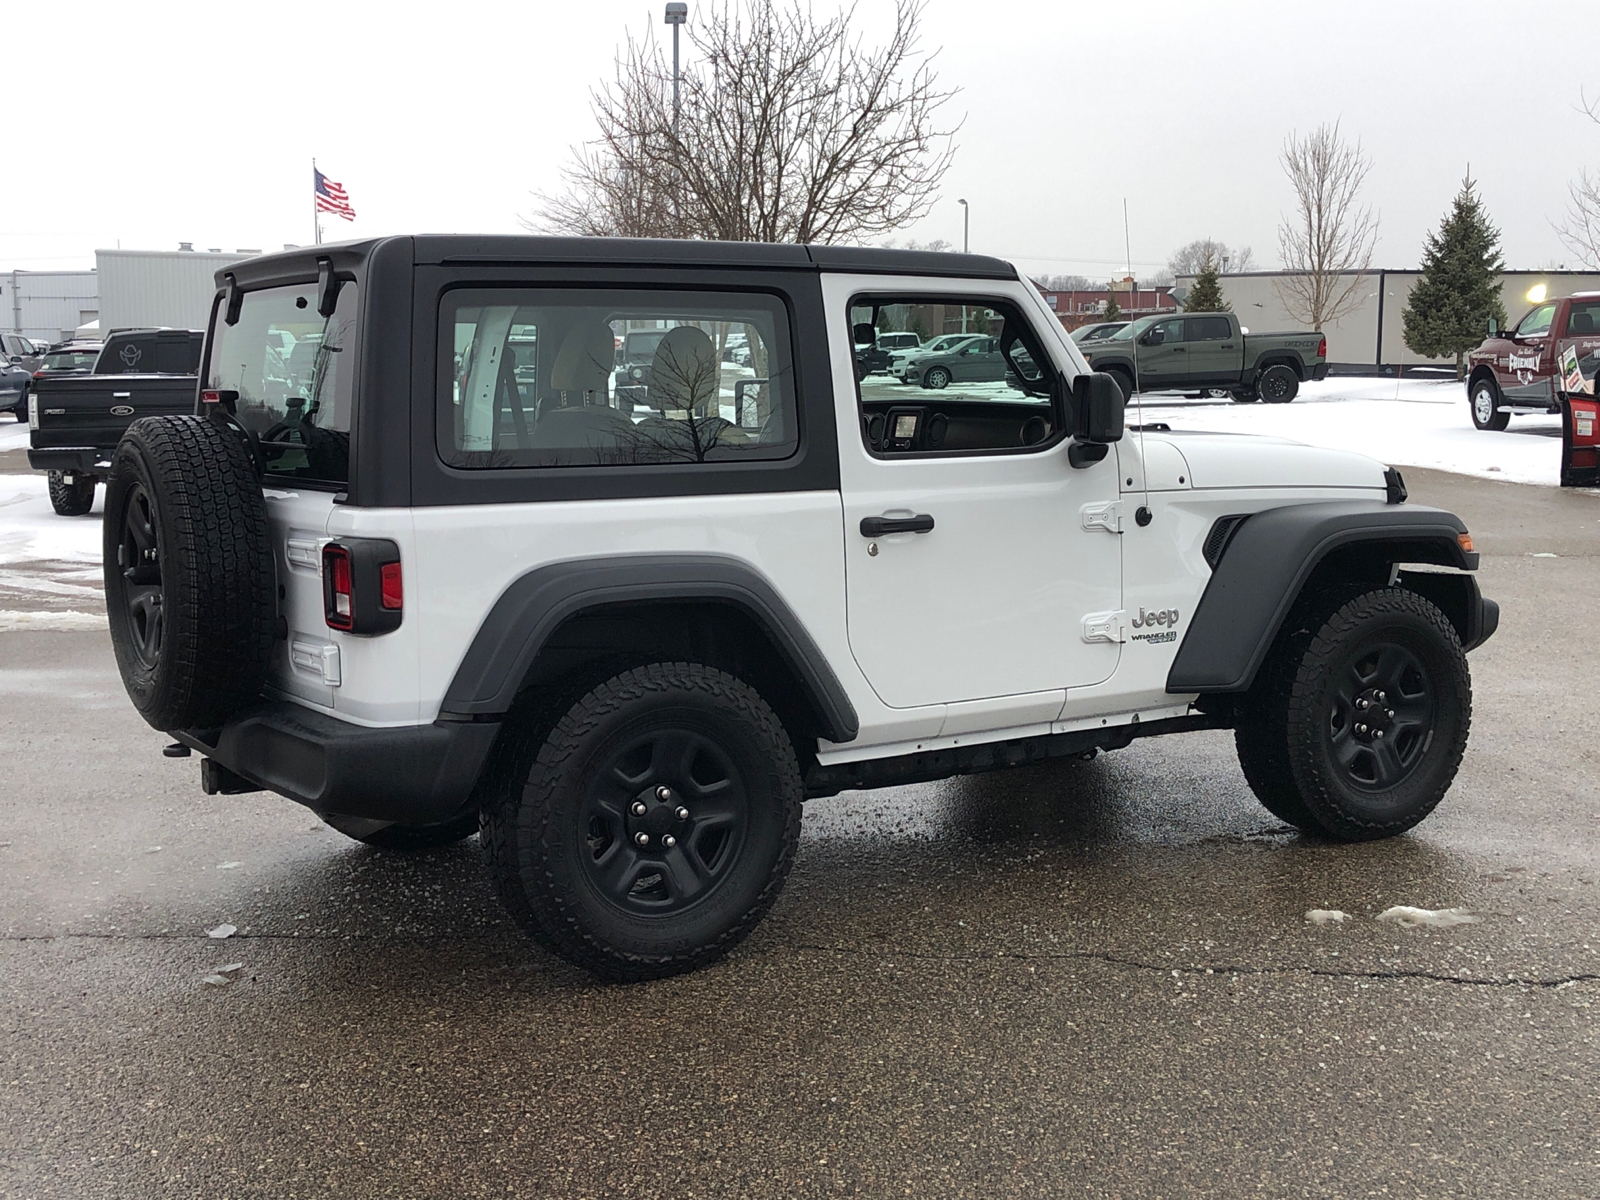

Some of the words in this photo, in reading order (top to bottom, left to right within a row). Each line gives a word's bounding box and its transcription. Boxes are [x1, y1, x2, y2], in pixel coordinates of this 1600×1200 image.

[1509, 352, 1542, 373] FRIENDLY
[1132, 606, 1179, 628] Jeep
[1131, 631, 1177, 640] WRANGLER
